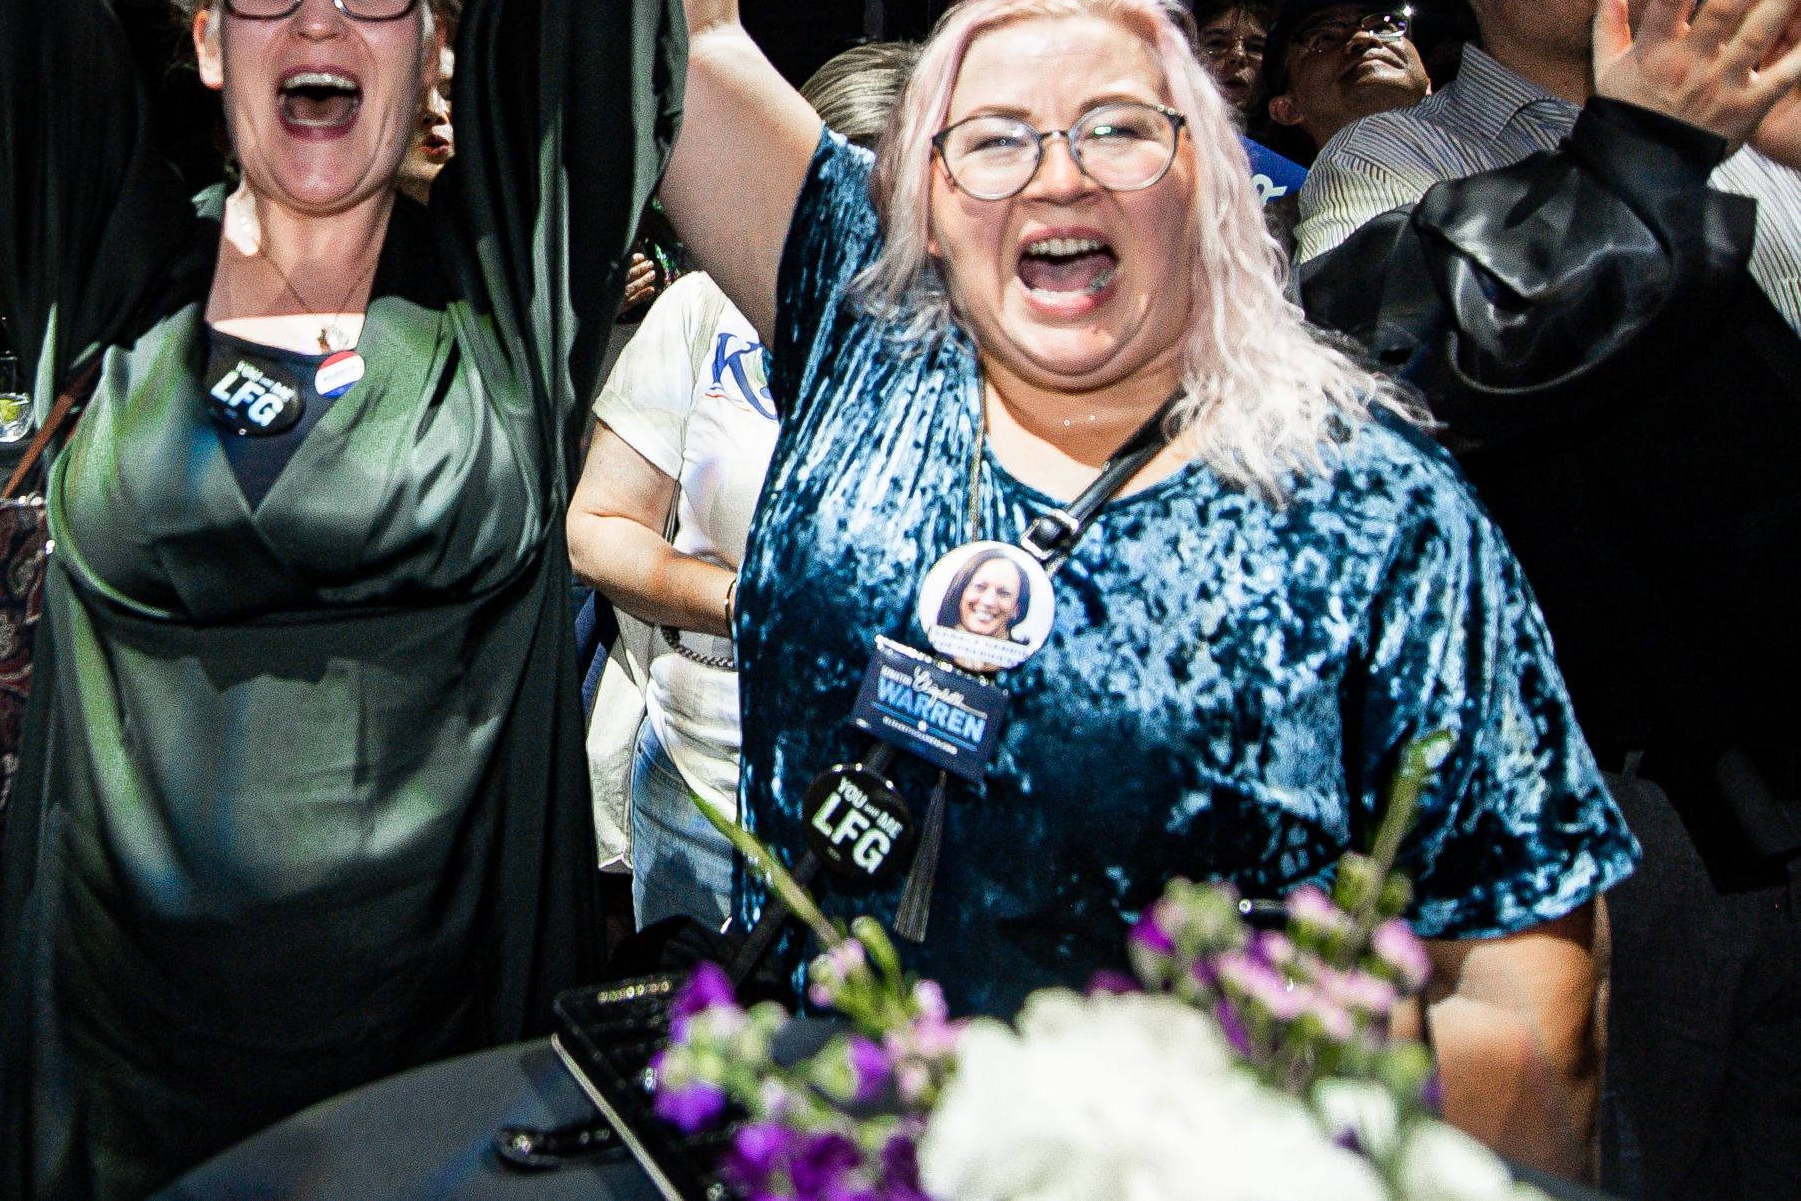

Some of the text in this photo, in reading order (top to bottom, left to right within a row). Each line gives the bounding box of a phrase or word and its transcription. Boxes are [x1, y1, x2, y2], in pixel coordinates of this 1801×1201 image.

[210, 370, 285, 427] LFG
[876, 675, 987, 744] WARREN
[837, 775, 868, 810] YOU
[810, 790, 892, 876] LFG
